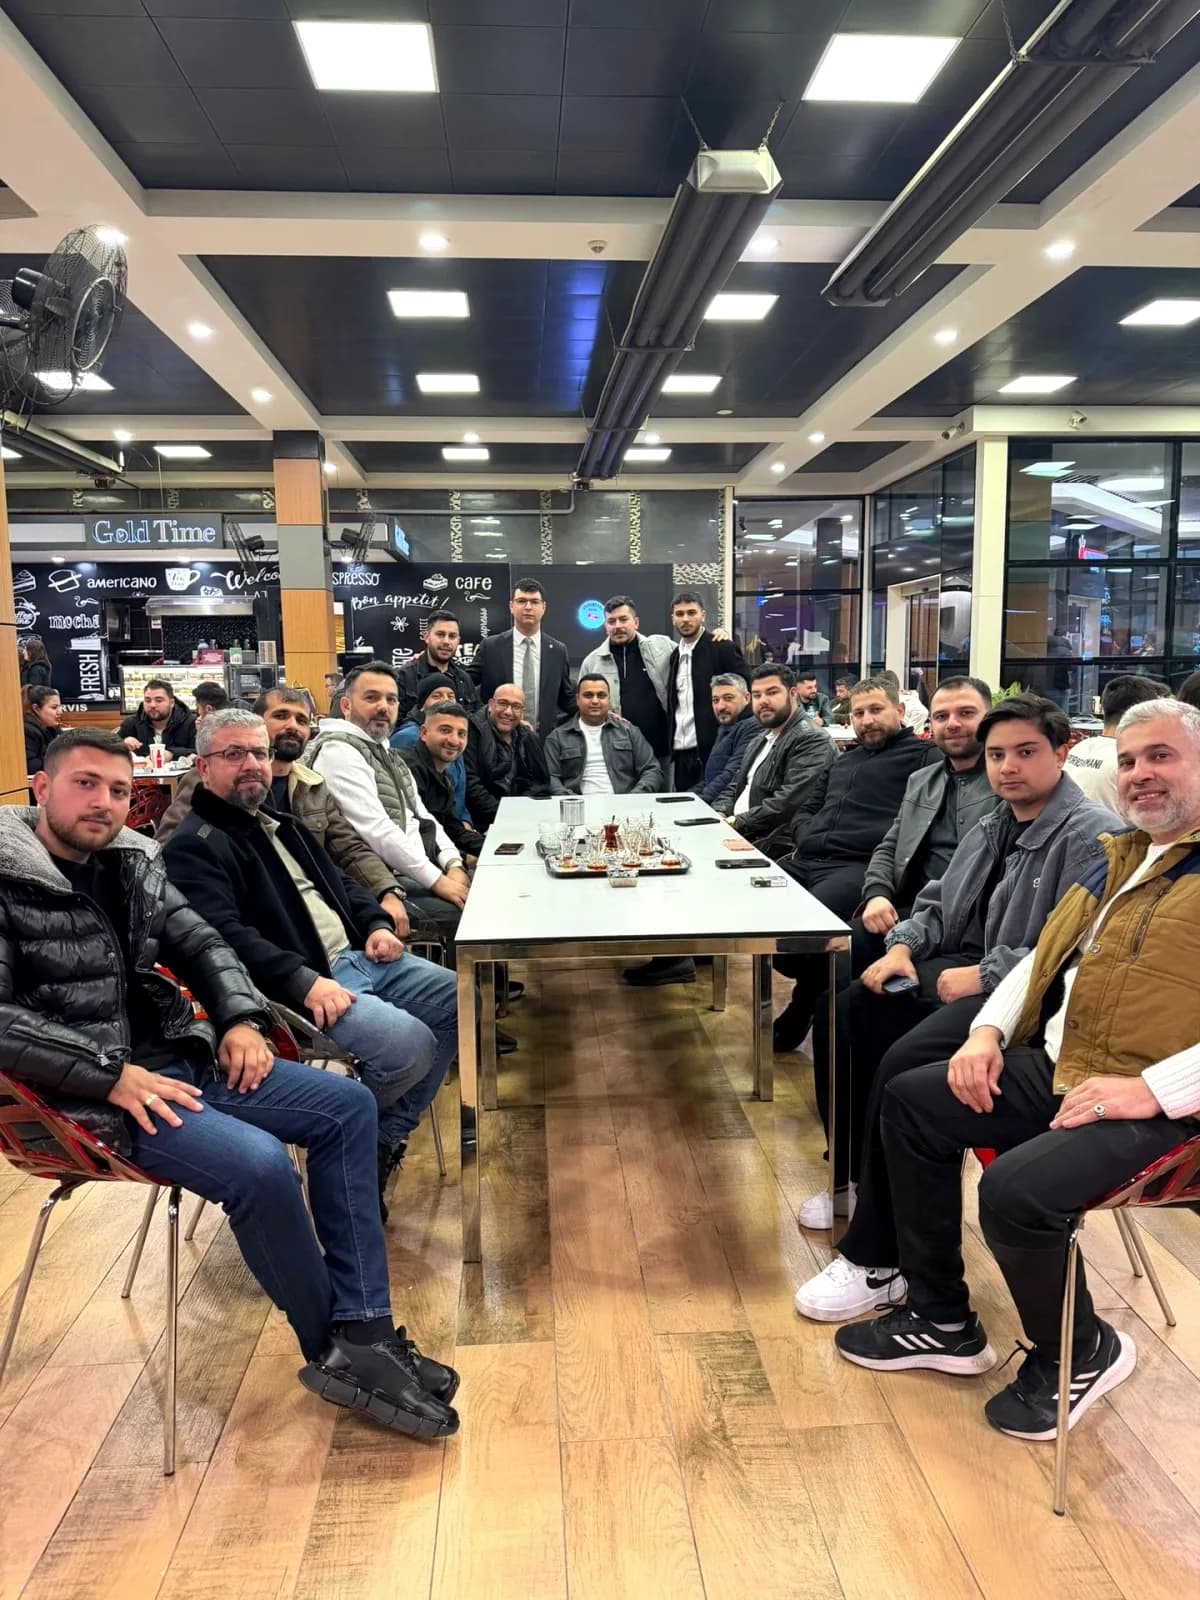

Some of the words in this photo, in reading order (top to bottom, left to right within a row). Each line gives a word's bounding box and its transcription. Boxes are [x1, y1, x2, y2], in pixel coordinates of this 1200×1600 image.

[92, 519, 151, 544] Gold
[153, 519, 216, 543] Time
[210, 567, 281, 590] Welco
[48, 613, 101, 629] mocha
[78, 653, 101, 691] FRESH
